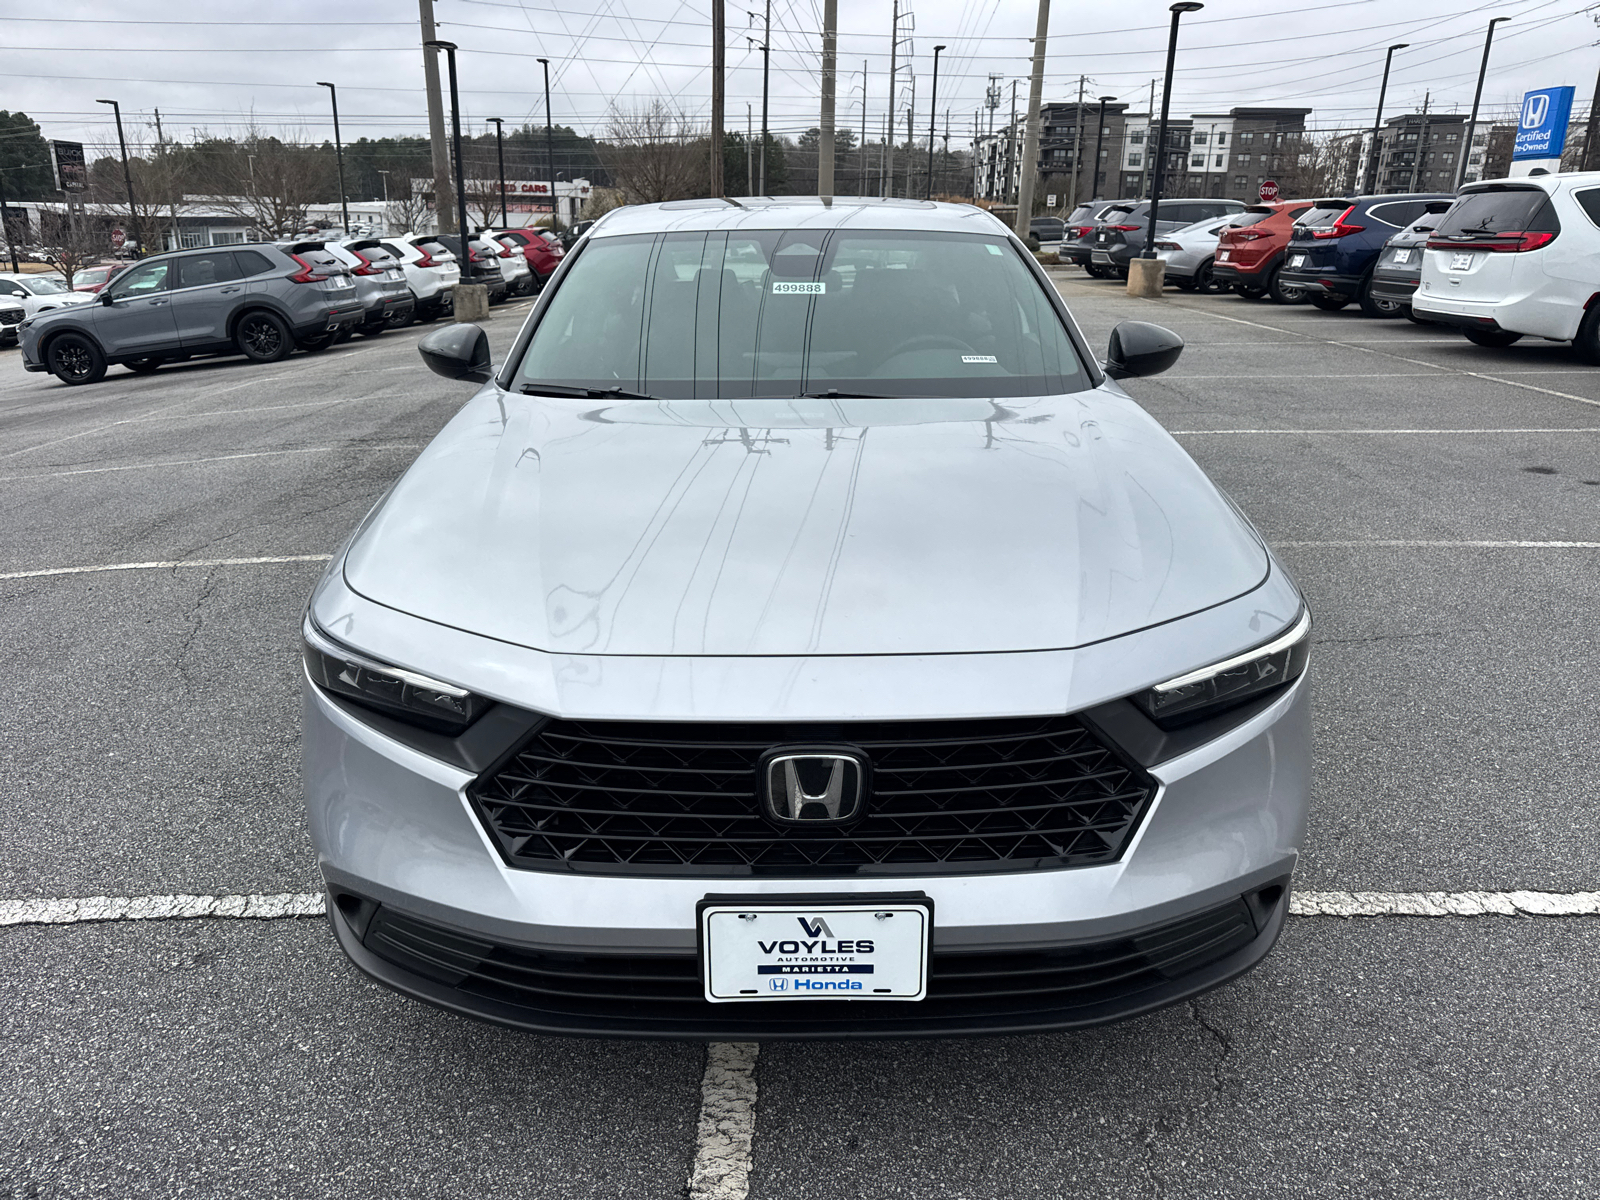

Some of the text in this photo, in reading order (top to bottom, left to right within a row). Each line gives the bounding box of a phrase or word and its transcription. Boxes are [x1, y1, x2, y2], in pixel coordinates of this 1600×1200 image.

[1515, 129, 1551, 143] Certified
[58, 147, 82, 156] BUICK
[1513, 141, 1549, 152] Pre-Owned
[521, 184, 548, 193] CARS
[1260, 186, 1278, 195] STOP
[774, 283, 821, 293] 499888
[757, 940, 875, 954] VOYLES
[794, 978, 863, 990] Honda
